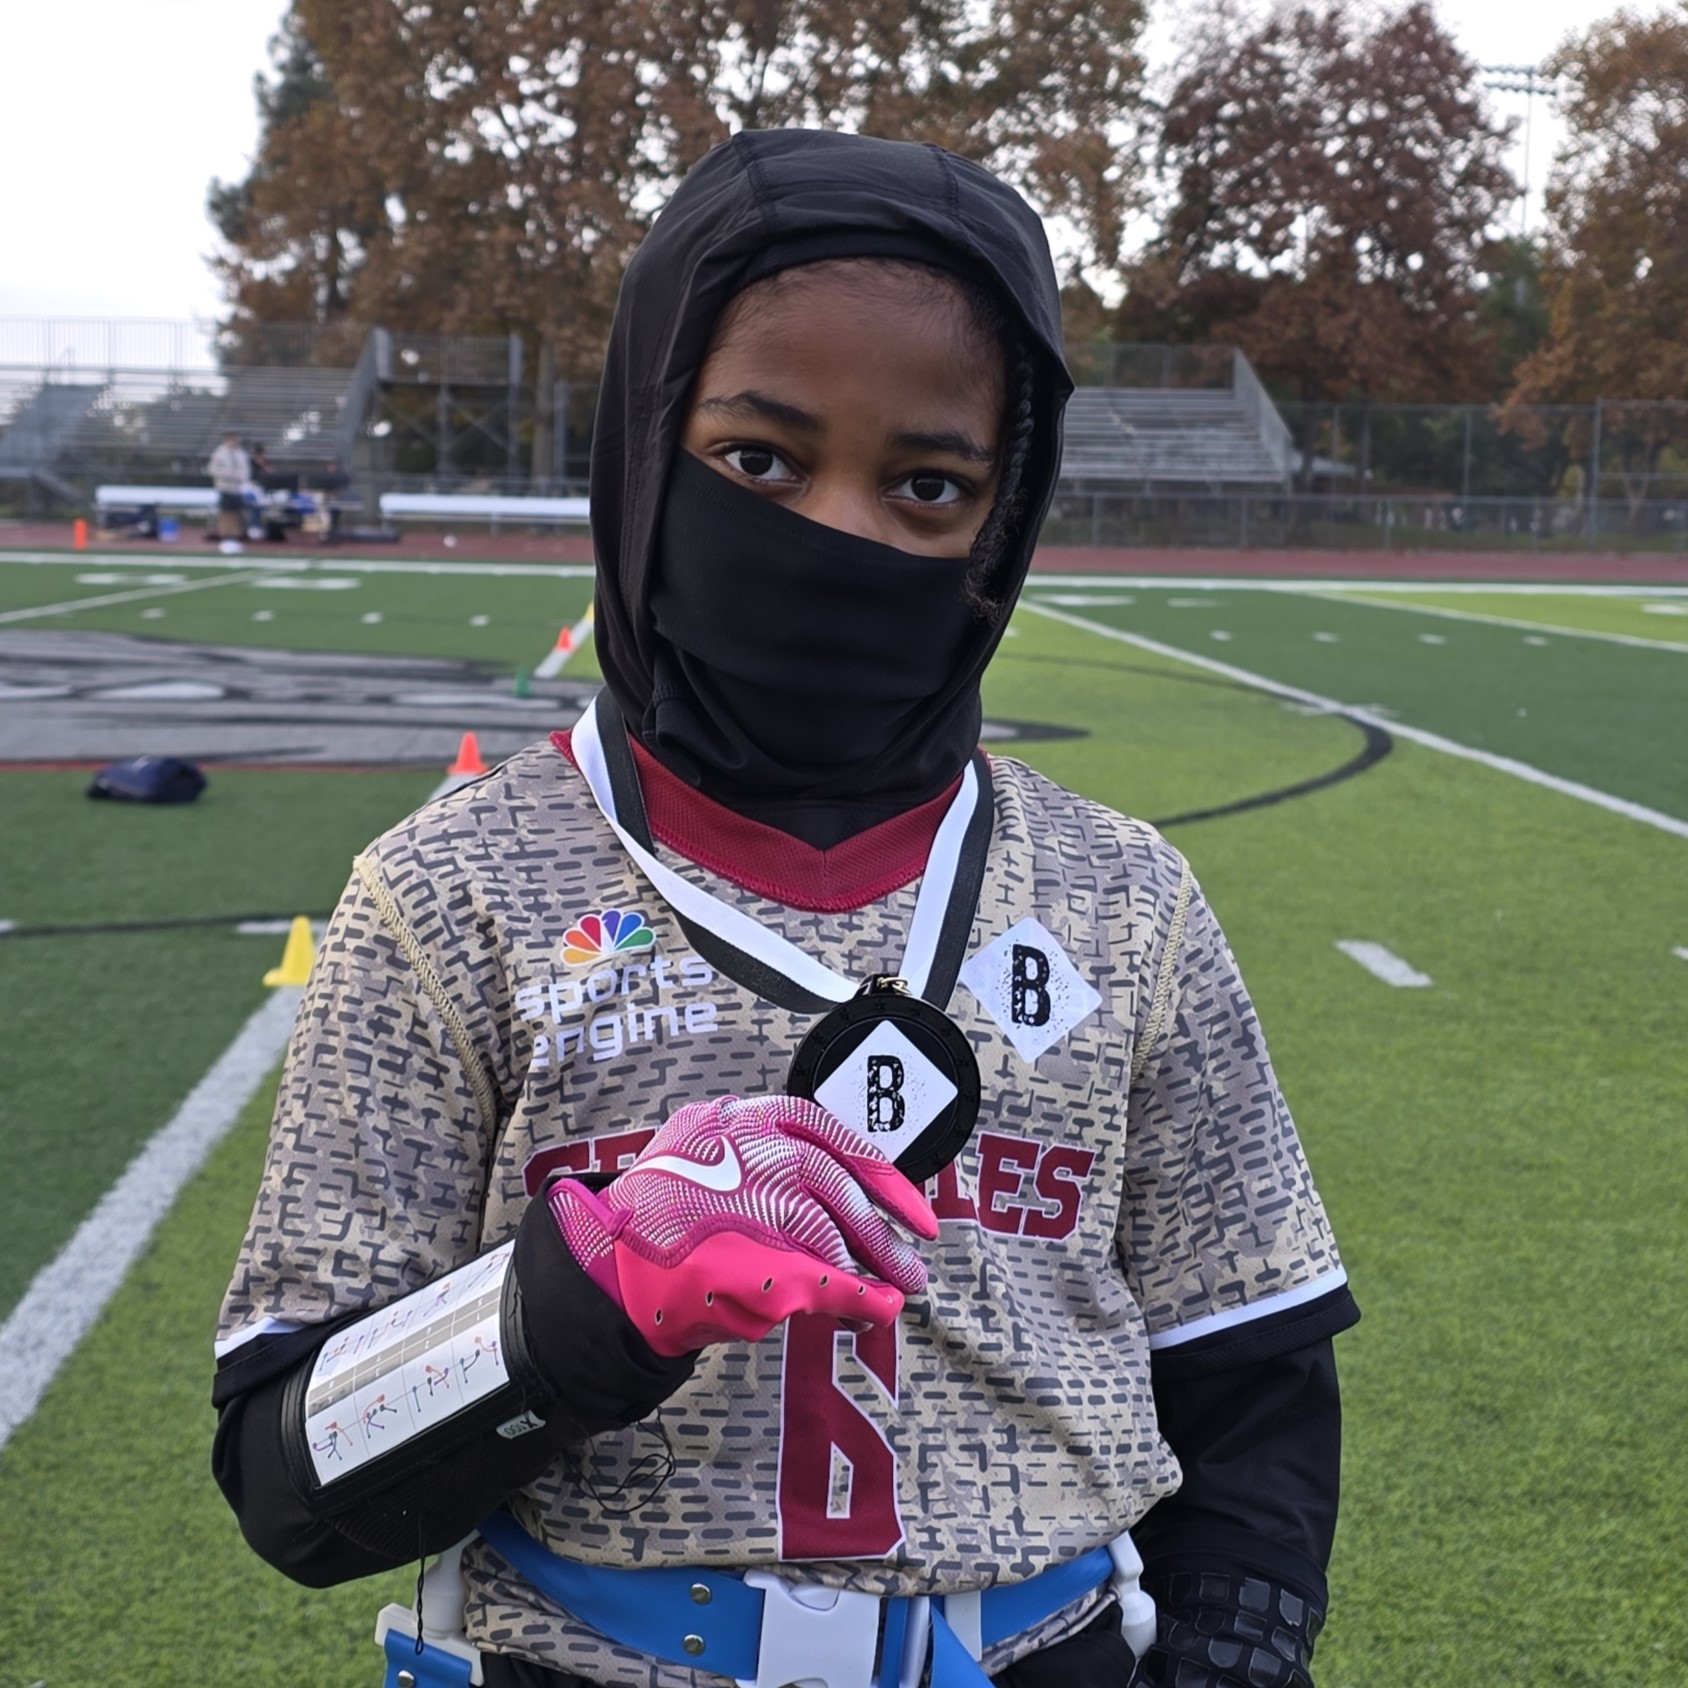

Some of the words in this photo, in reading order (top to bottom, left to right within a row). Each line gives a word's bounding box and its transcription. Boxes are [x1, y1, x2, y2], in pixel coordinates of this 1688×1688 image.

[514, 955, 713, 1024] sports
[1012, 943, 1051, 1027] B
[867, 1055, 905, 1132] B
[776, 1311, 907, 1562] 6
